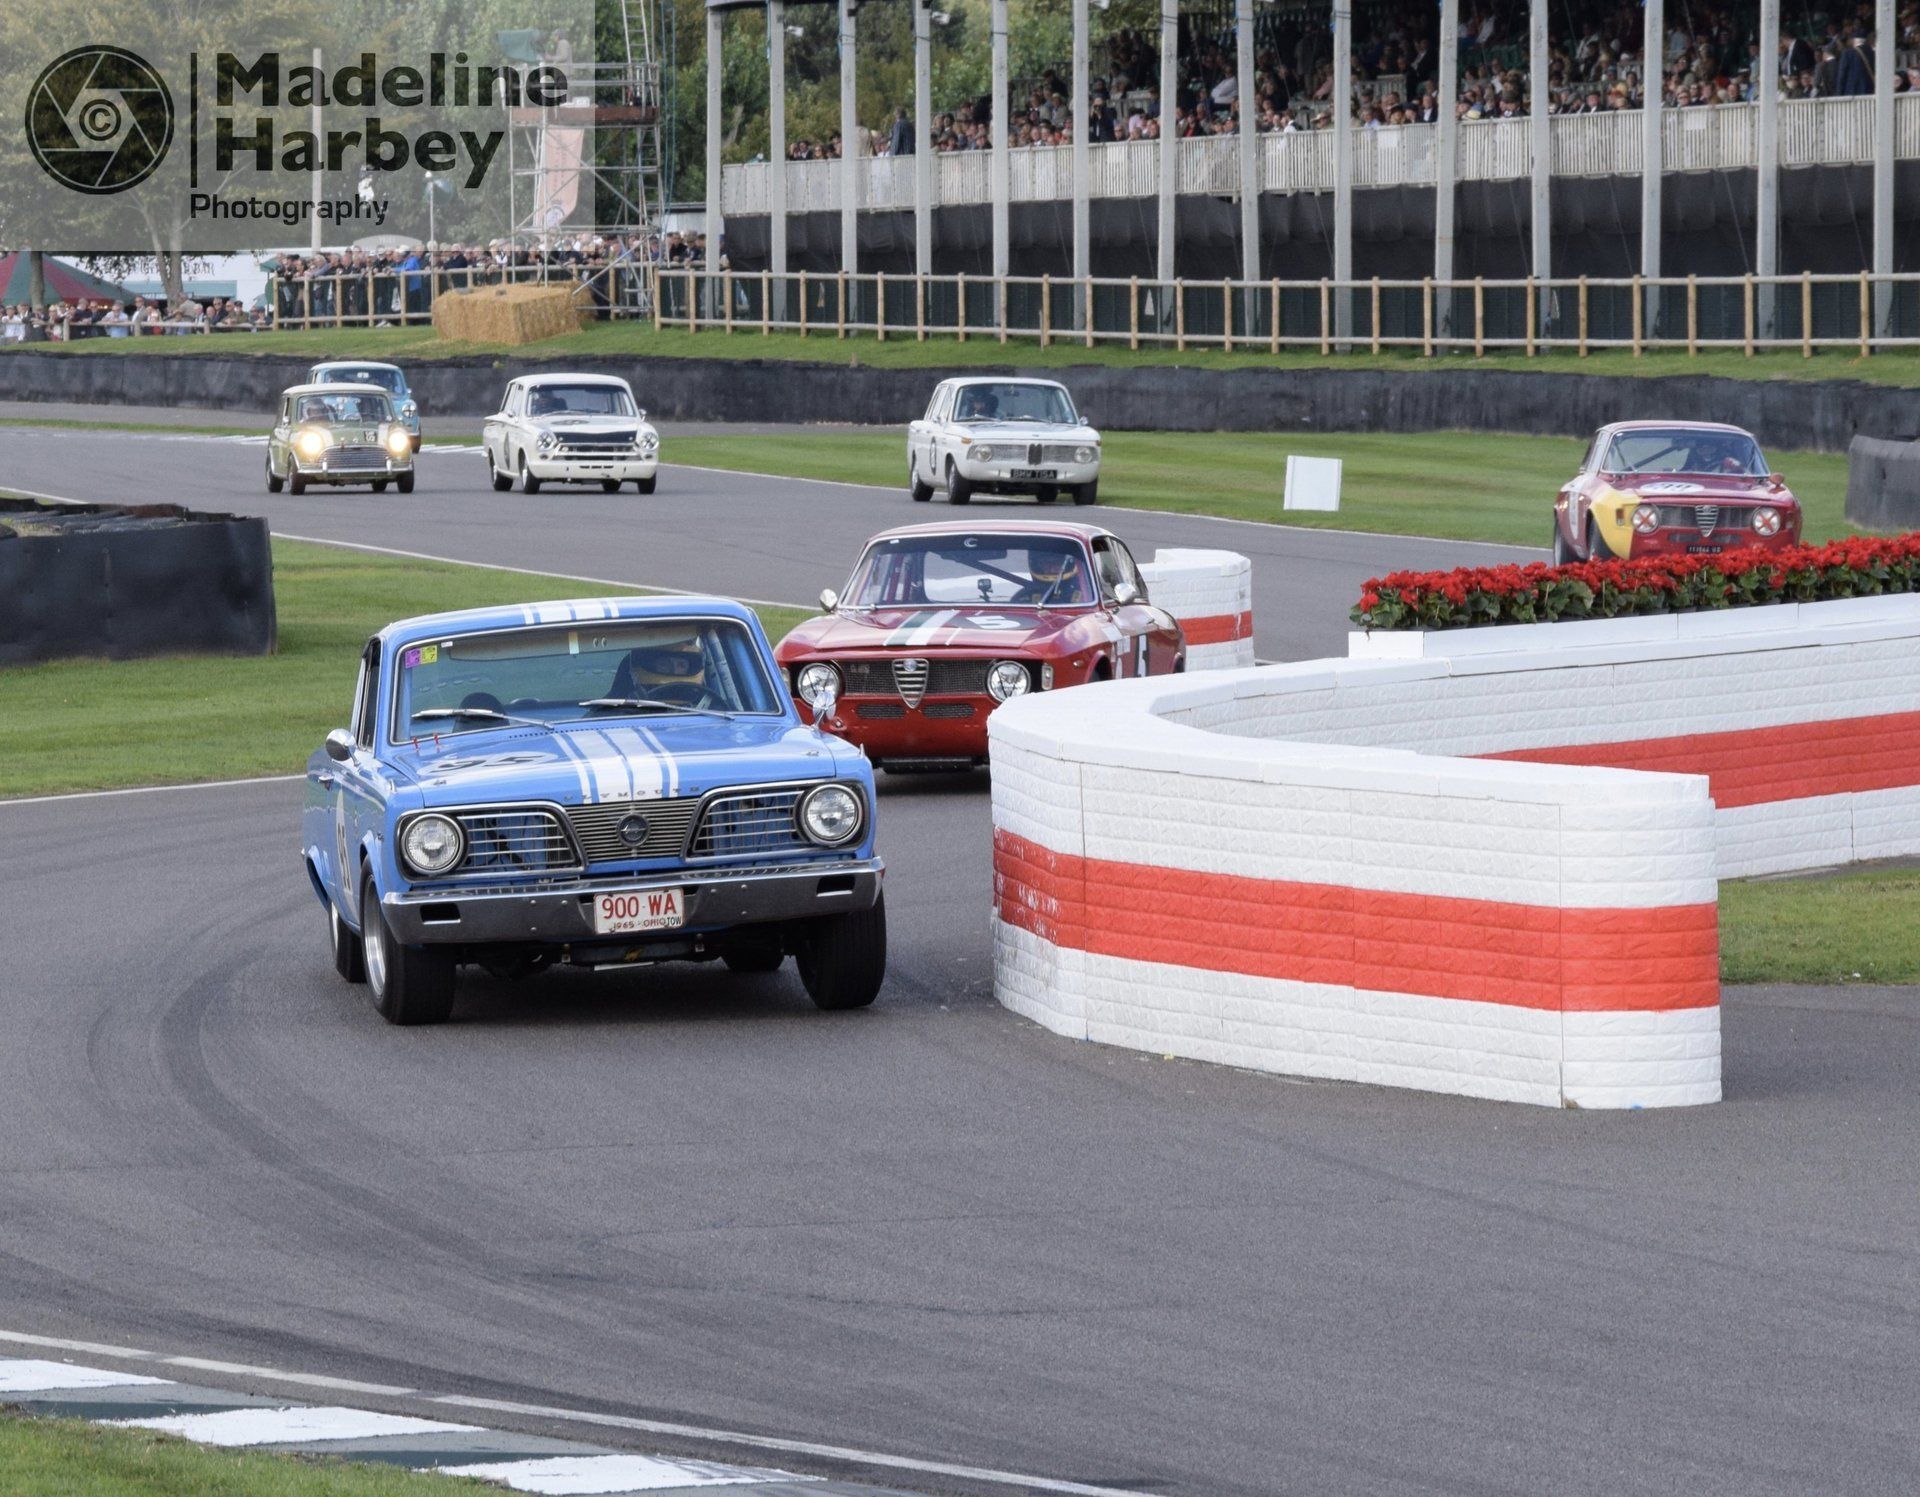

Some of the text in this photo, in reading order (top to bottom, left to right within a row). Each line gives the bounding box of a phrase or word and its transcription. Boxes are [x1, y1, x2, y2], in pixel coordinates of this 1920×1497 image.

[965, 615, 1021, 630] 5
[602, 893, 677, 920] 900 WA
[643, 917, 667, 928] OHIO
